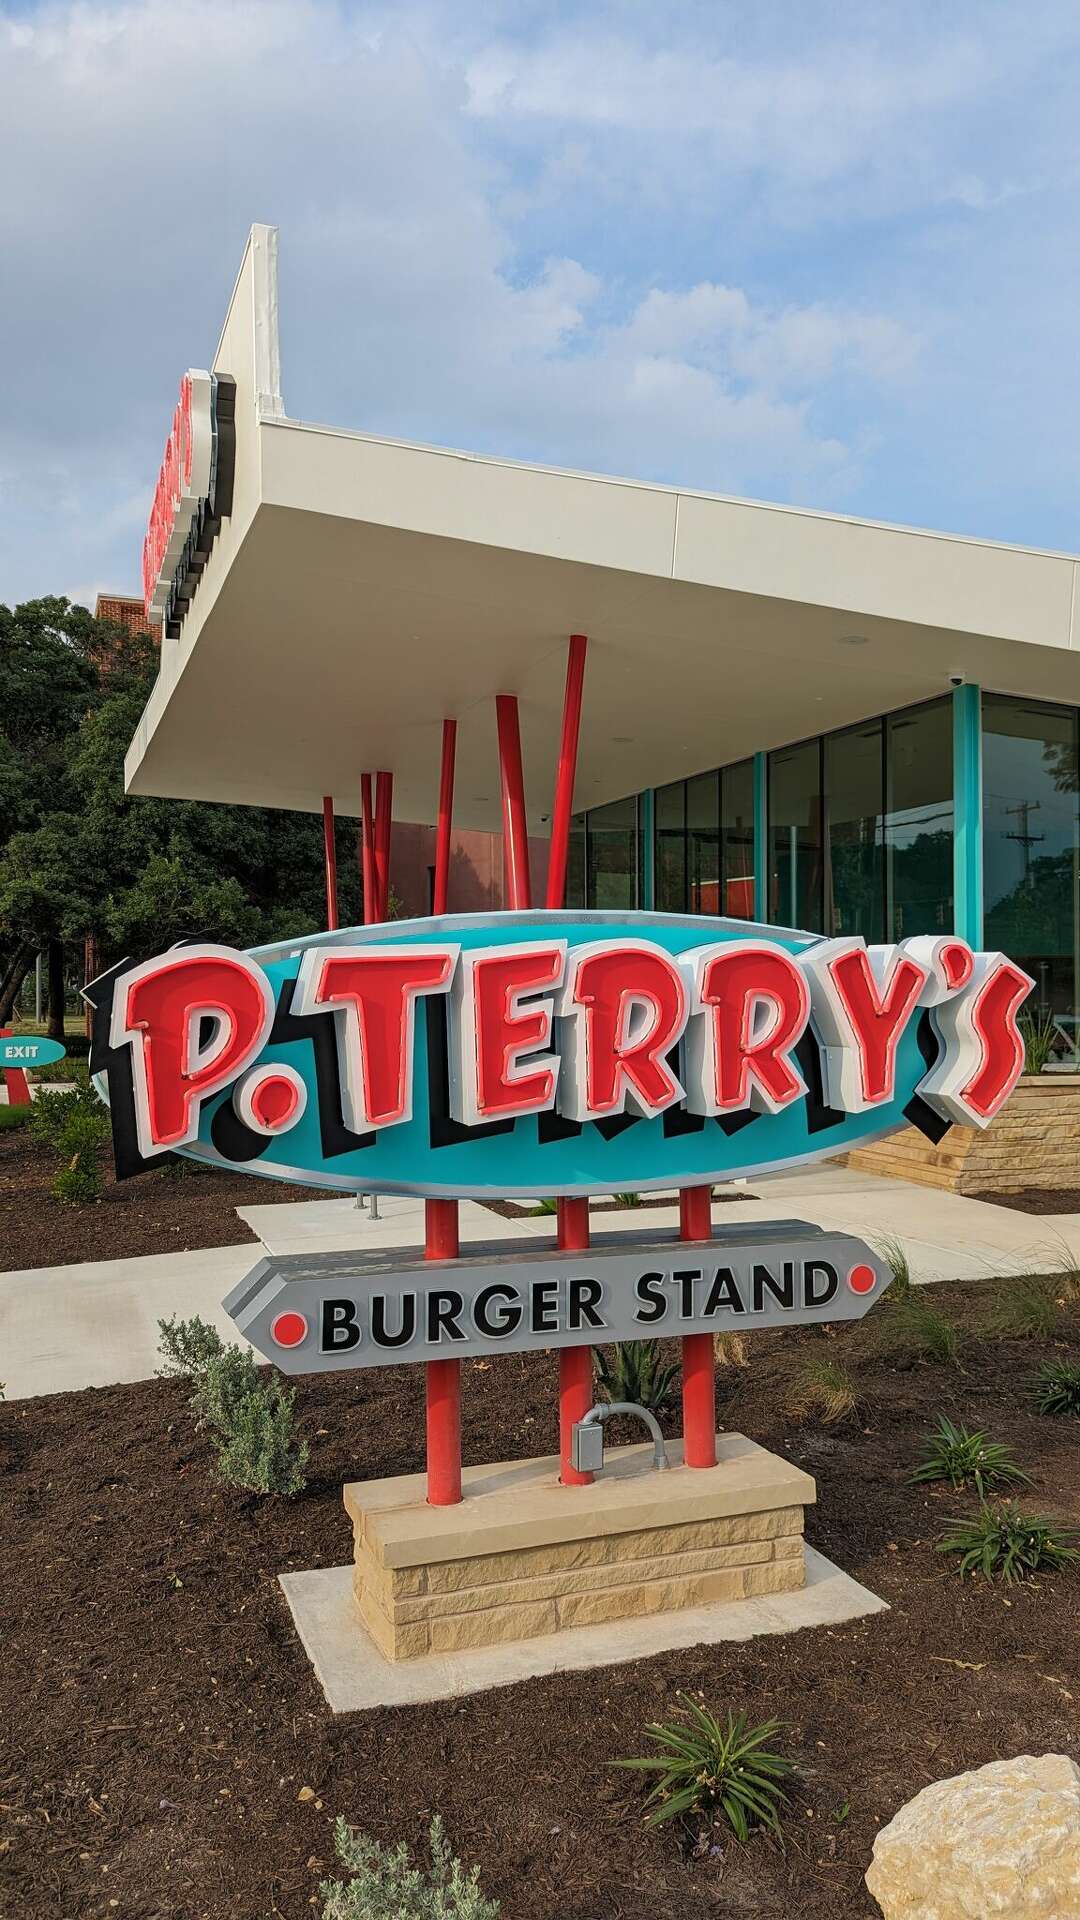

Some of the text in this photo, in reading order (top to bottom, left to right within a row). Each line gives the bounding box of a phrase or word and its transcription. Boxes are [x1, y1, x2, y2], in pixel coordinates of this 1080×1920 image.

[5, 1046, 39, 1058] EXIT
[319, 1260, 840, 1353] BURGER STAND
